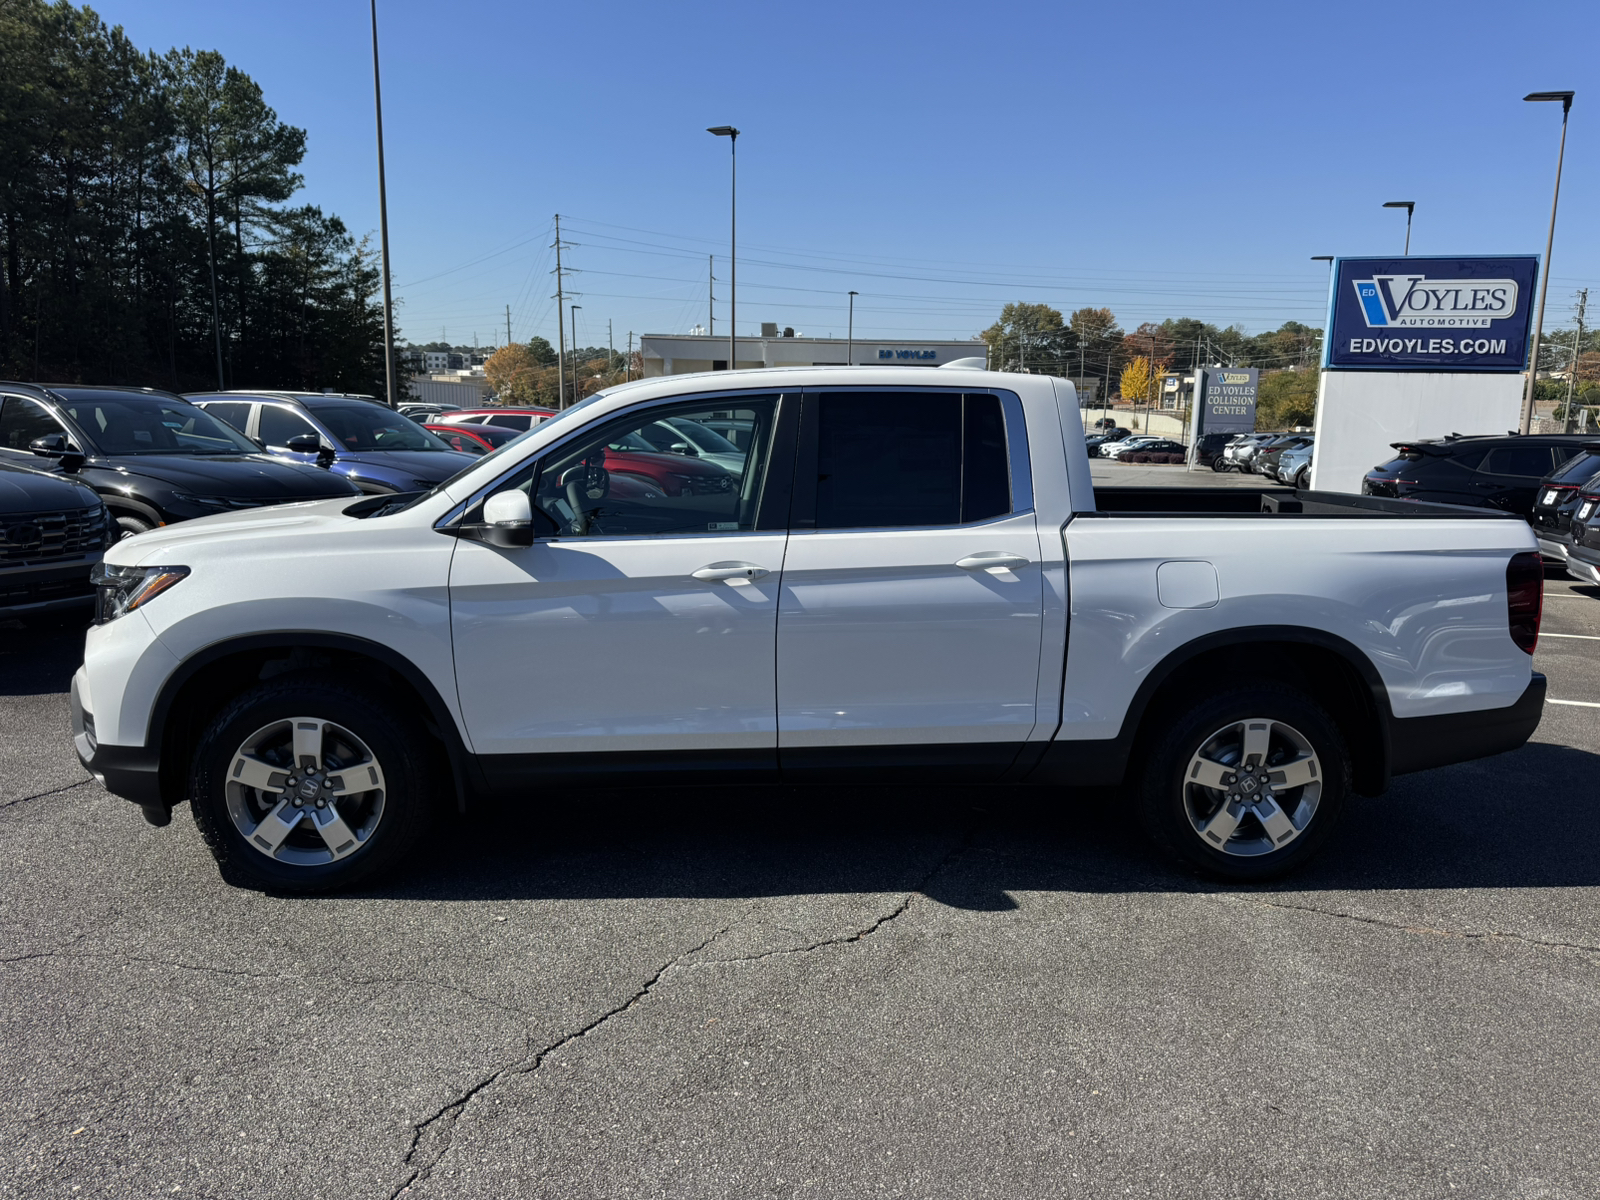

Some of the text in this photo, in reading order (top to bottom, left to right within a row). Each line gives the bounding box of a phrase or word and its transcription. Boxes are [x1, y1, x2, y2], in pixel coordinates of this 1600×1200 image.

[1362, 277, 1507, 321] ED VOYLES
[1400, 318, 1489, 326] AUTOMOTIVE
[1349, 338, 1507, 354] EDVOYLES.COM
[878, 349, 937, 359] ED VOYLES
[1208, 386, 1255, 396] ED VOYLES
[1207, 396, 1254, 405] COLLISION
[1212, 406, 1247, 415] CENTER
